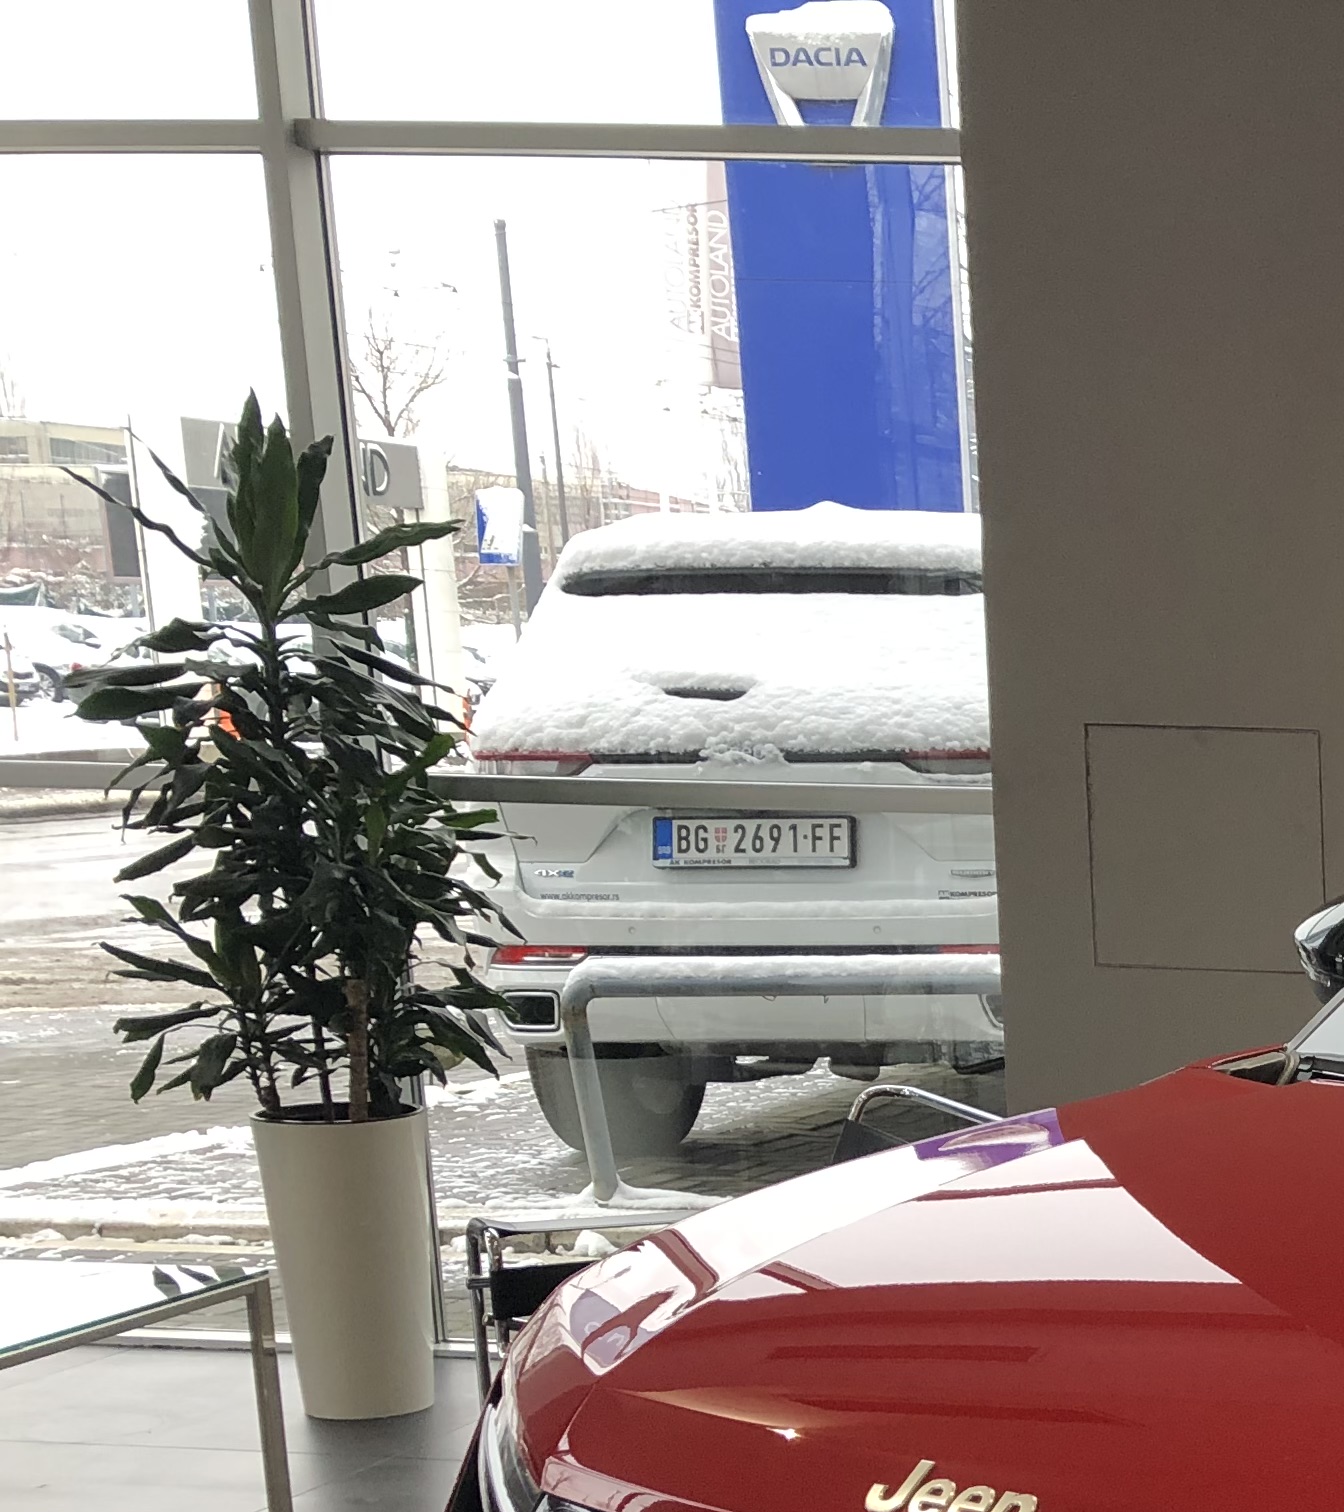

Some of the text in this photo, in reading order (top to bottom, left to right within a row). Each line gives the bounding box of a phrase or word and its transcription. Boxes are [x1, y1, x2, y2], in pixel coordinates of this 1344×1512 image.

[769, 47, 868, 67] DACIA
[707, 210, 732, 341] AUTOLAND
[676, 824, 709, 853] BG
